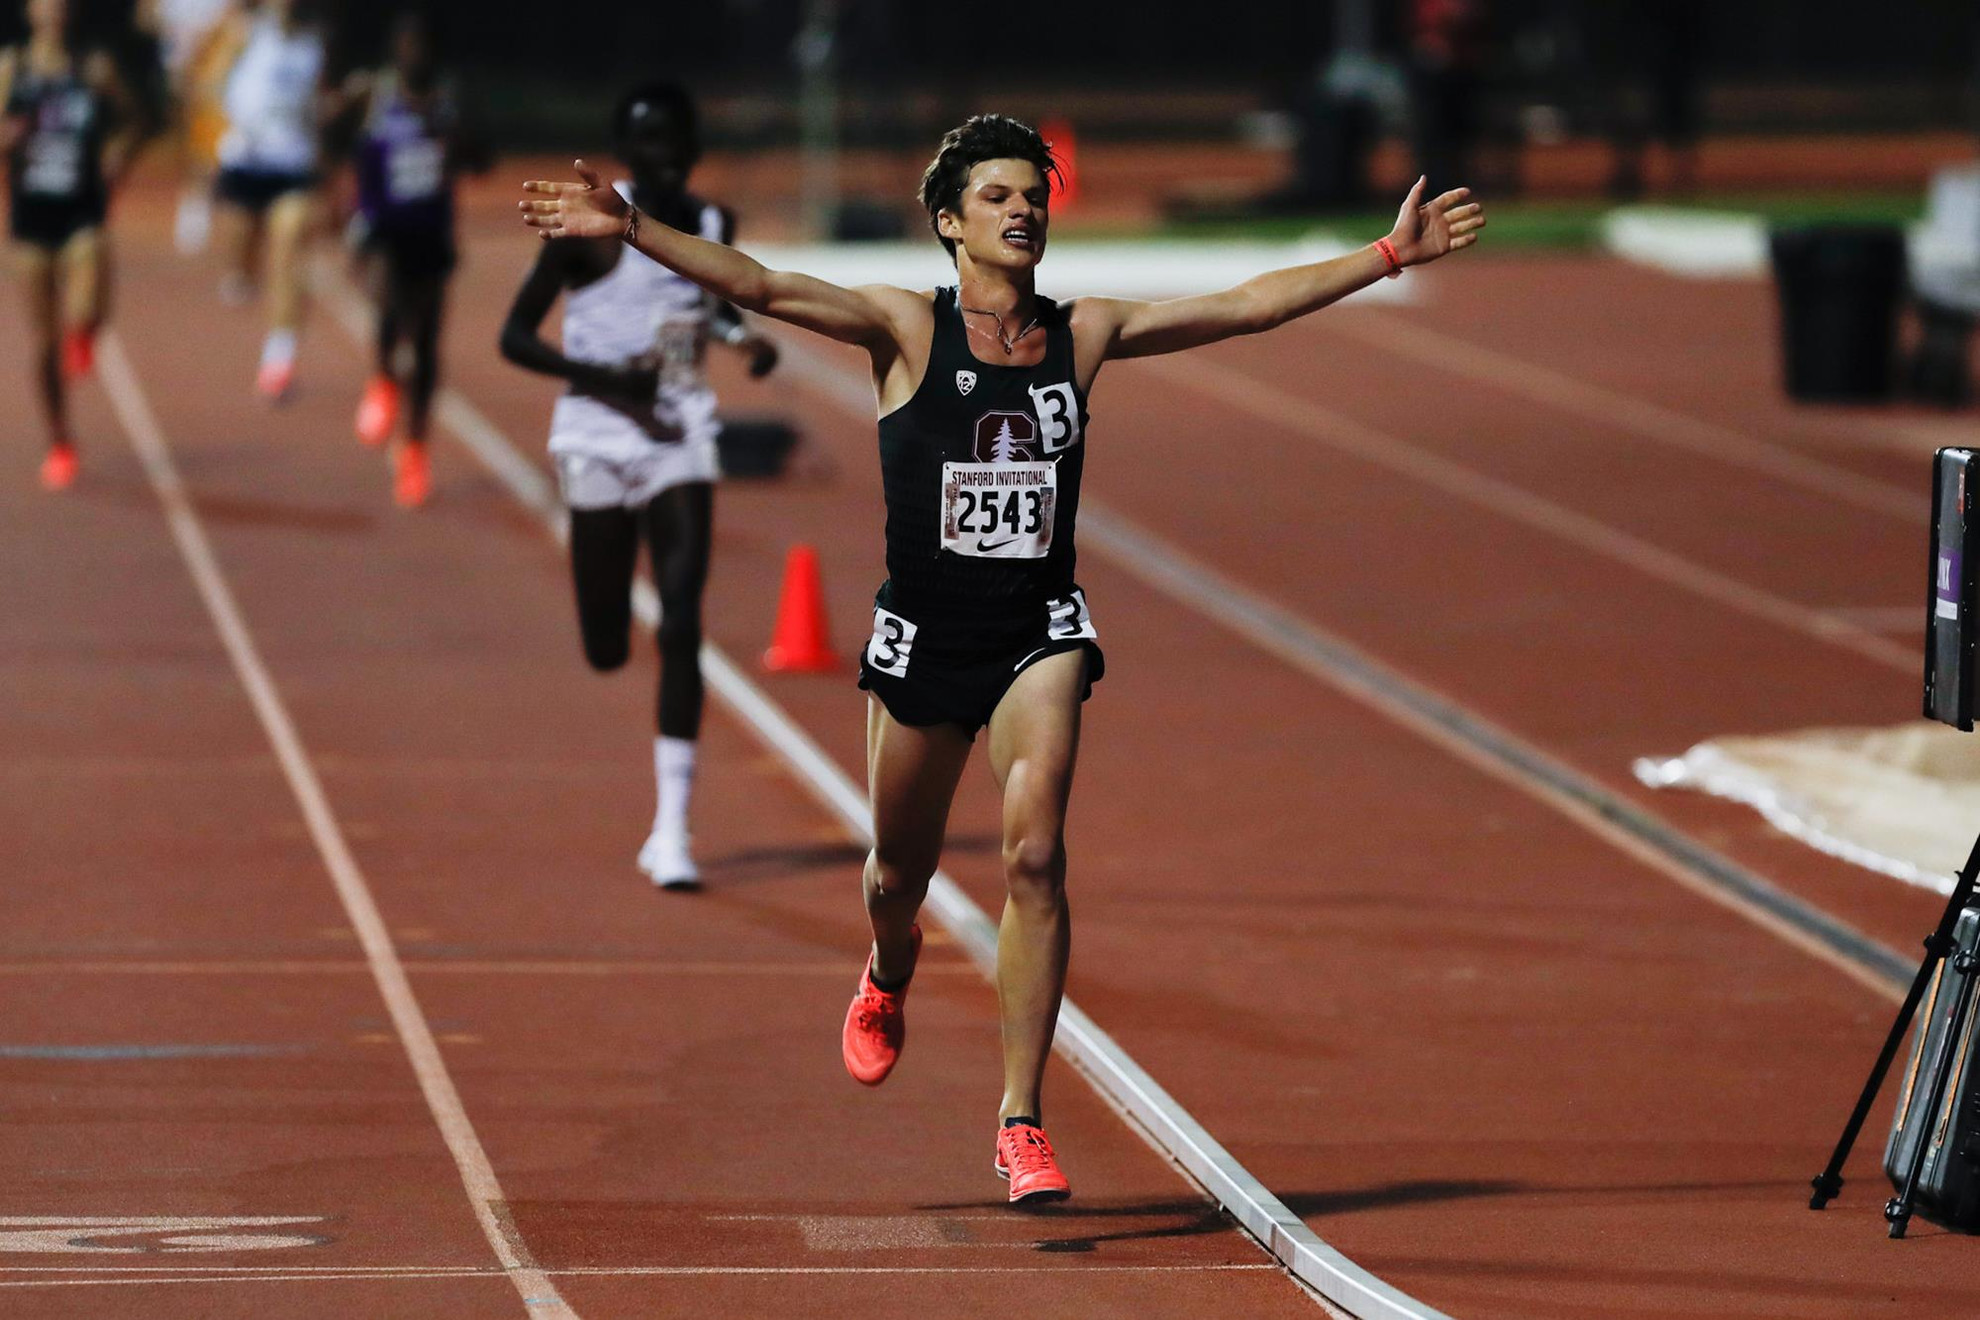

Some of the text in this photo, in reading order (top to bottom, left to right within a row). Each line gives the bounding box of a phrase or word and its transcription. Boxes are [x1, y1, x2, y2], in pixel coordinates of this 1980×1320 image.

[1042, 389, 1072, 448] 3
[952, 470, 1048, 487] STANFORD INVITATIONAL
[957, 490, 1042, 534] 2543
[1058, 595, 1083, 636] 3
[874, 617, 904, 669] 3
